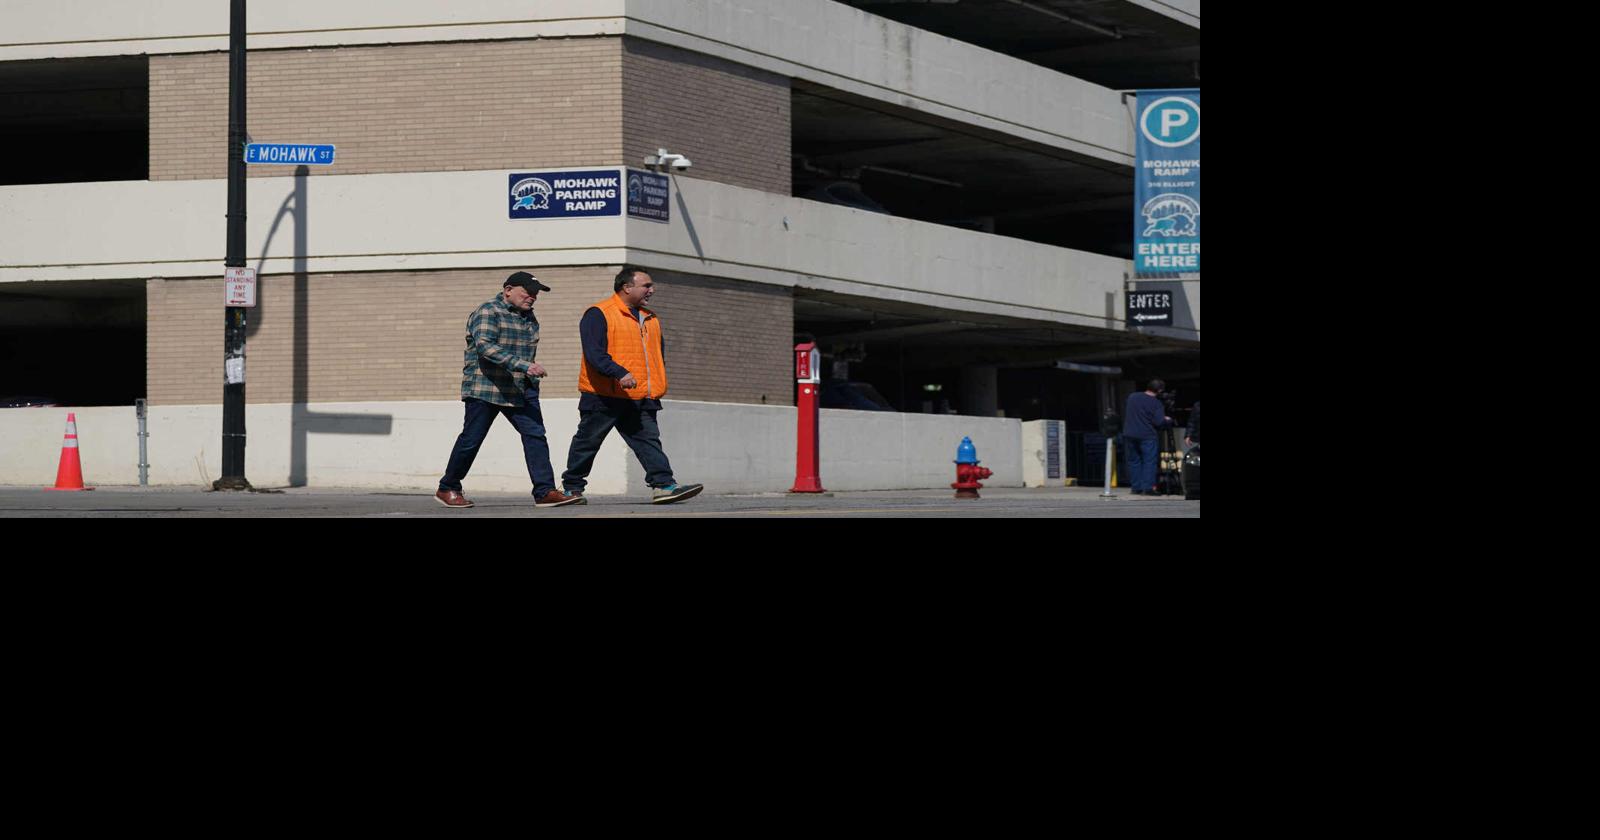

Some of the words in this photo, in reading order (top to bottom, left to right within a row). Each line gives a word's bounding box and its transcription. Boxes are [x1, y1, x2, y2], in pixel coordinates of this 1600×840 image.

[1161, 109, 1189, 136] P
[249, 149, 255, 158] E
[259, 147, 316, 162] MOHAWK
[320, 151, 330, 159] ST
[1143, 160, 1200, 168] MOHAWK
[554, 178, 618, 188] MOHAWK
[555, 189, 616, 199] PARKING
[643, 186, 667, 197] PARKING
[565, 201, 606, 210] RAMP
[647, 196, 664, 206] RAMP
[1144, 255, 1197, 267] HERE
[1129, 294, 1170, 308] ENTER
